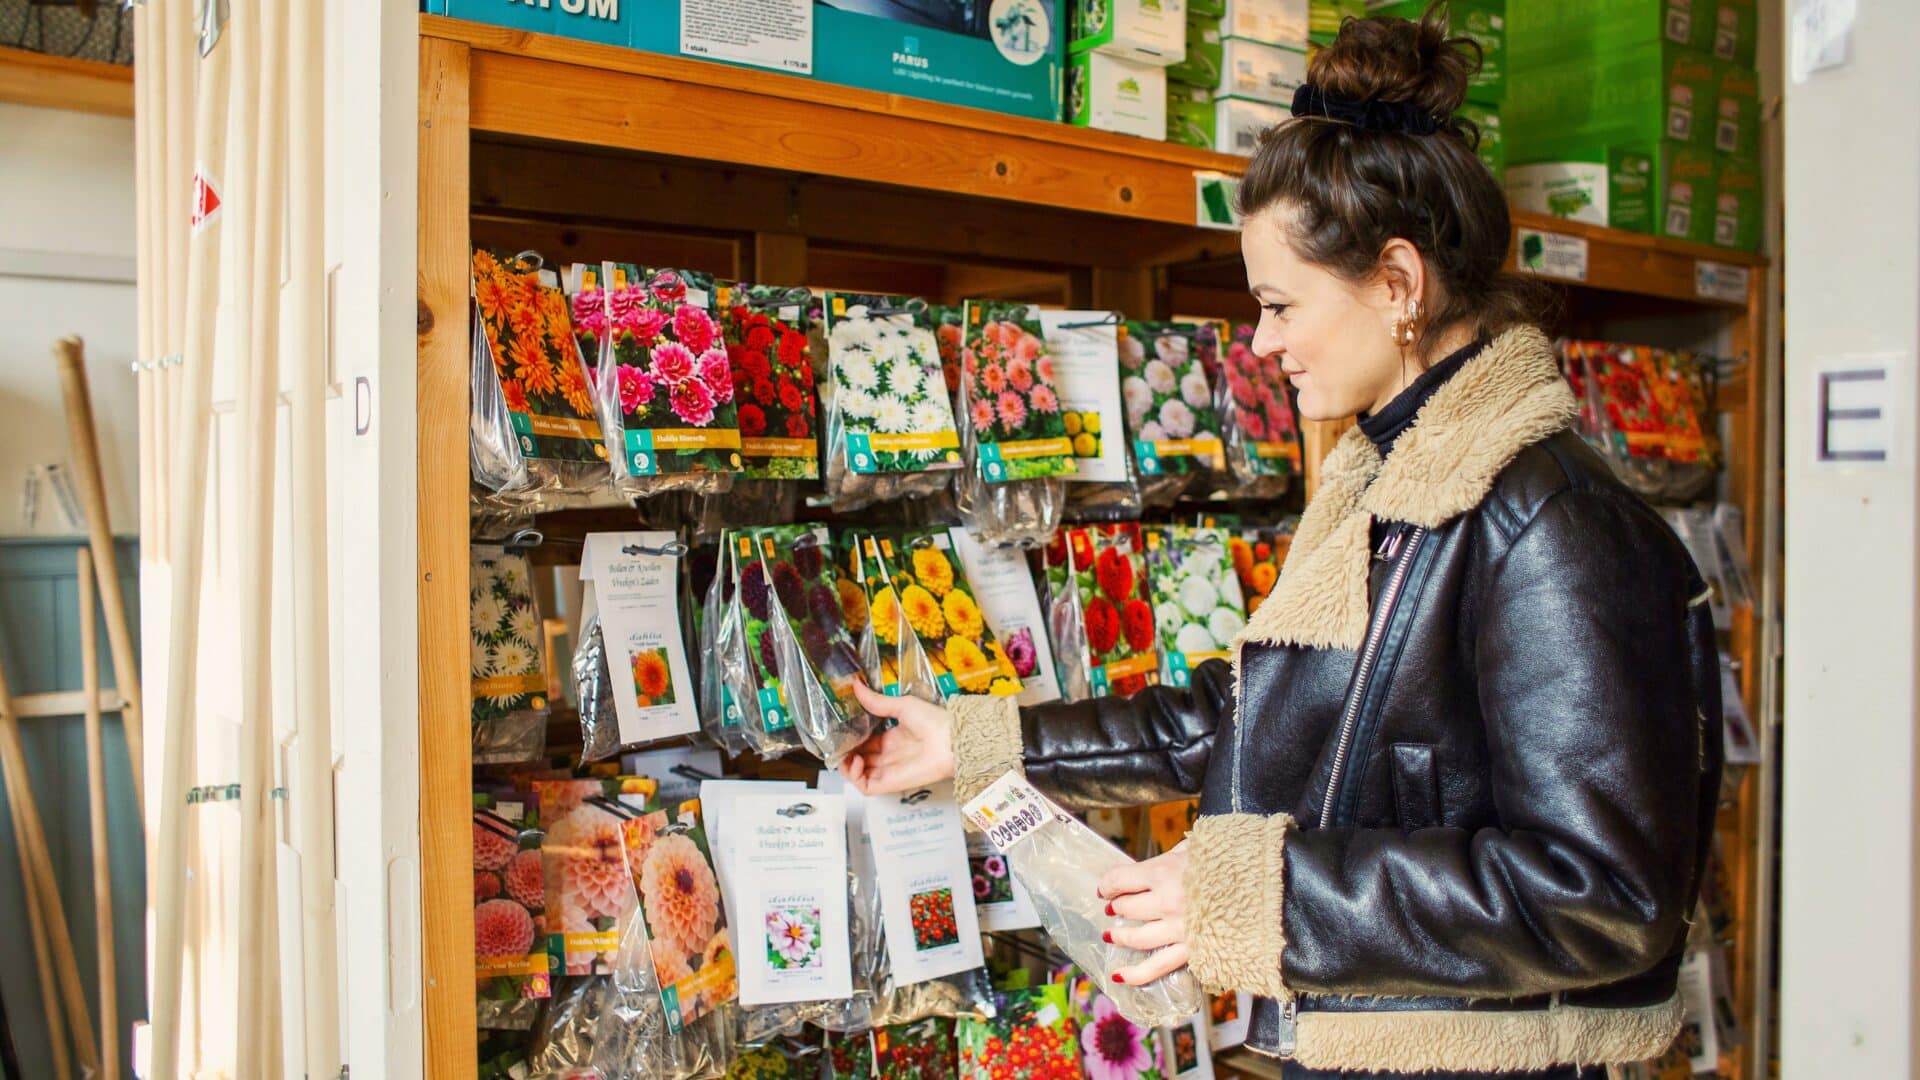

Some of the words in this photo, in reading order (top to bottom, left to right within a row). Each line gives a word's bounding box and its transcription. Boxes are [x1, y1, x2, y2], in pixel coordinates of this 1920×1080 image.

[892, 52, 928, 69] PARUS
[355, 376, 371, 436] D
[1818, 368, 1886, 461] E
[636, 434, 642, 446] 1
[855, 437, 861, 447] 1
